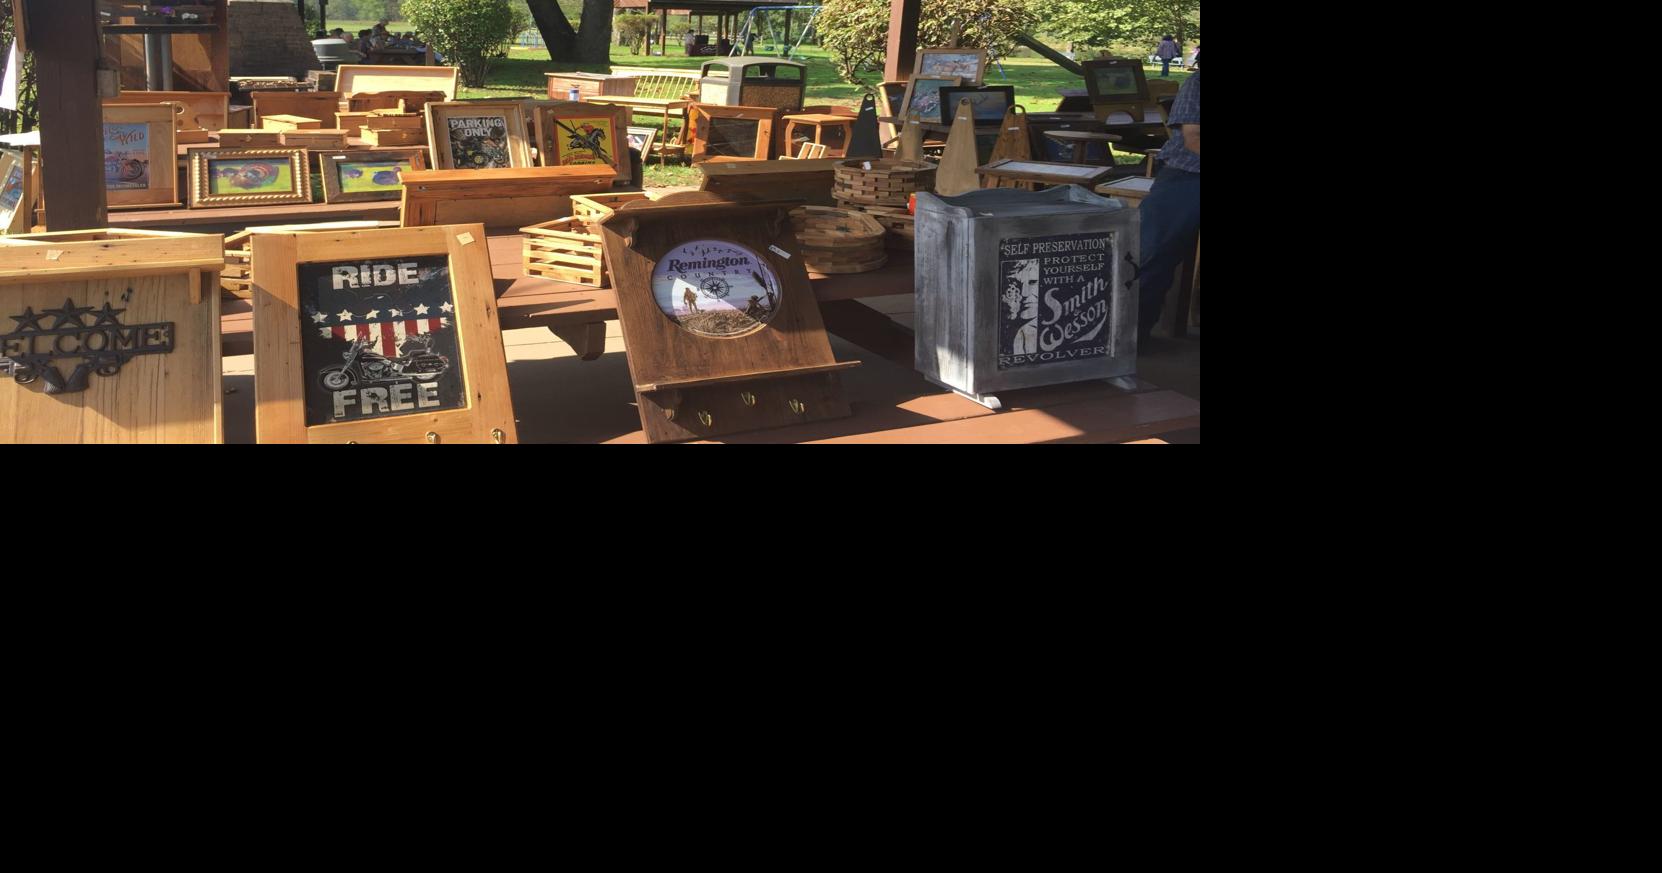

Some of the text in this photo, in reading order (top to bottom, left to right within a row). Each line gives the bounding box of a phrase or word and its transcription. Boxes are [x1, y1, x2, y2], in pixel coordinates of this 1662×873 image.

[451, 118, 502, 128] PARKING
[464, 128, 492, 137] ONLY
[668, 256, 750, 274] Remington
[1044, 253, 1105, 265] PROTECT
[332, 262, 419, 290] RIDE
[667, 268, 751, 281] COUNTRY
[1044, 263, 1105, 275] YOURSELF
[1043, 274, 1085, 285] WITH A
[1041, 277, 1107, 325] Smith
[1040, 300, 1106, 351] Wesson
[0, 322, 170, 358] ELCOME
[332, 381, 440, 418] FREE
